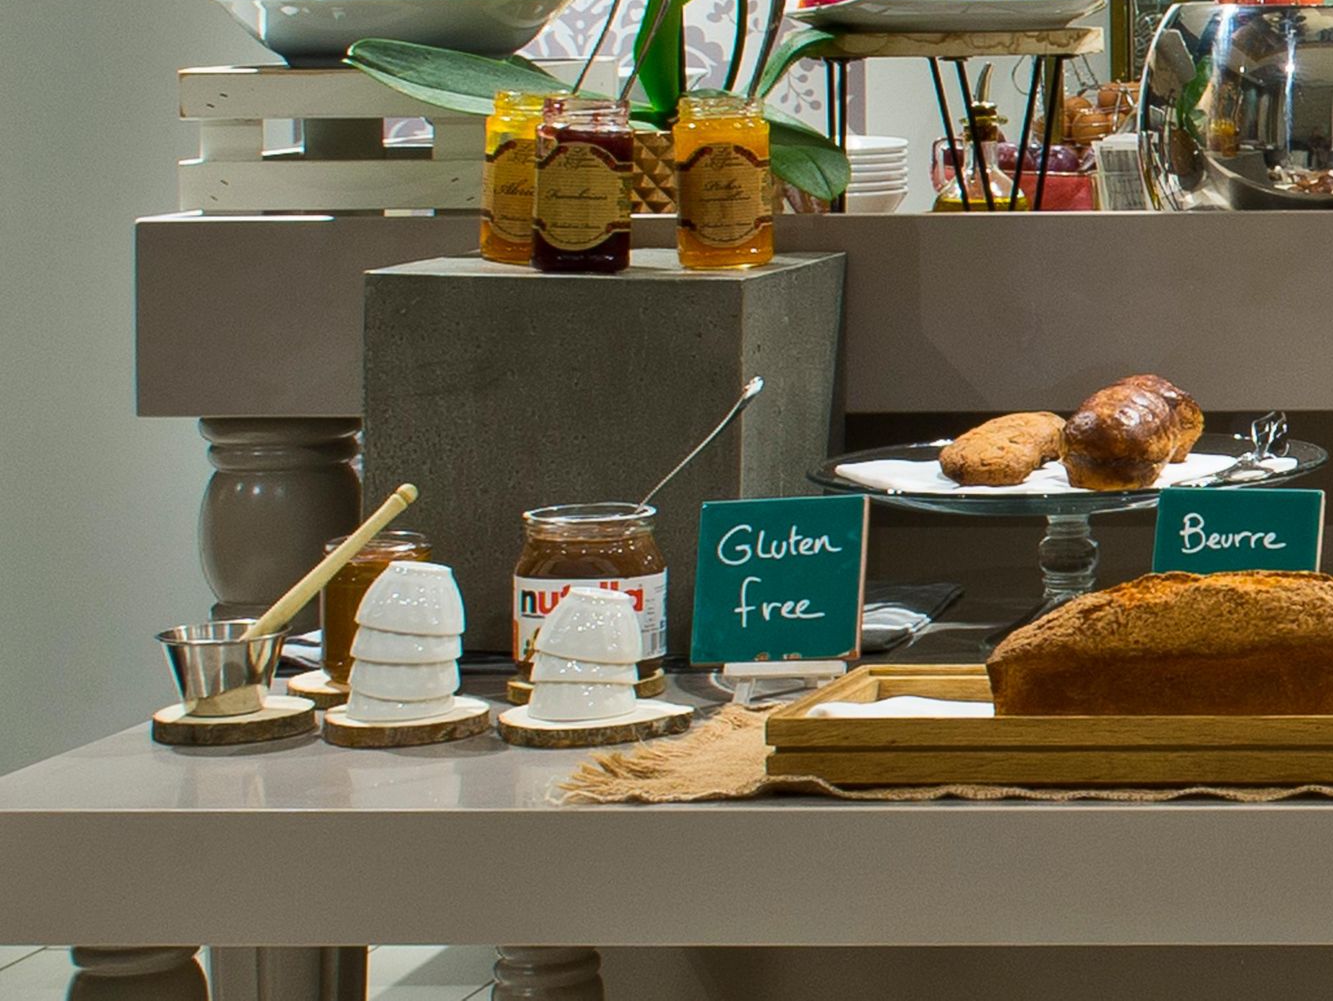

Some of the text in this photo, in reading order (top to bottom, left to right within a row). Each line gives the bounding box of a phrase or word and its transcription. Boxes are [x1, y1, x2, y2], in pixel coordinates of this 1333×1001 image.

[717, 524, 842, 566] Gluten
[1179, 512, 1287, 554] Beurre
[734, 576, 825, 628] free
